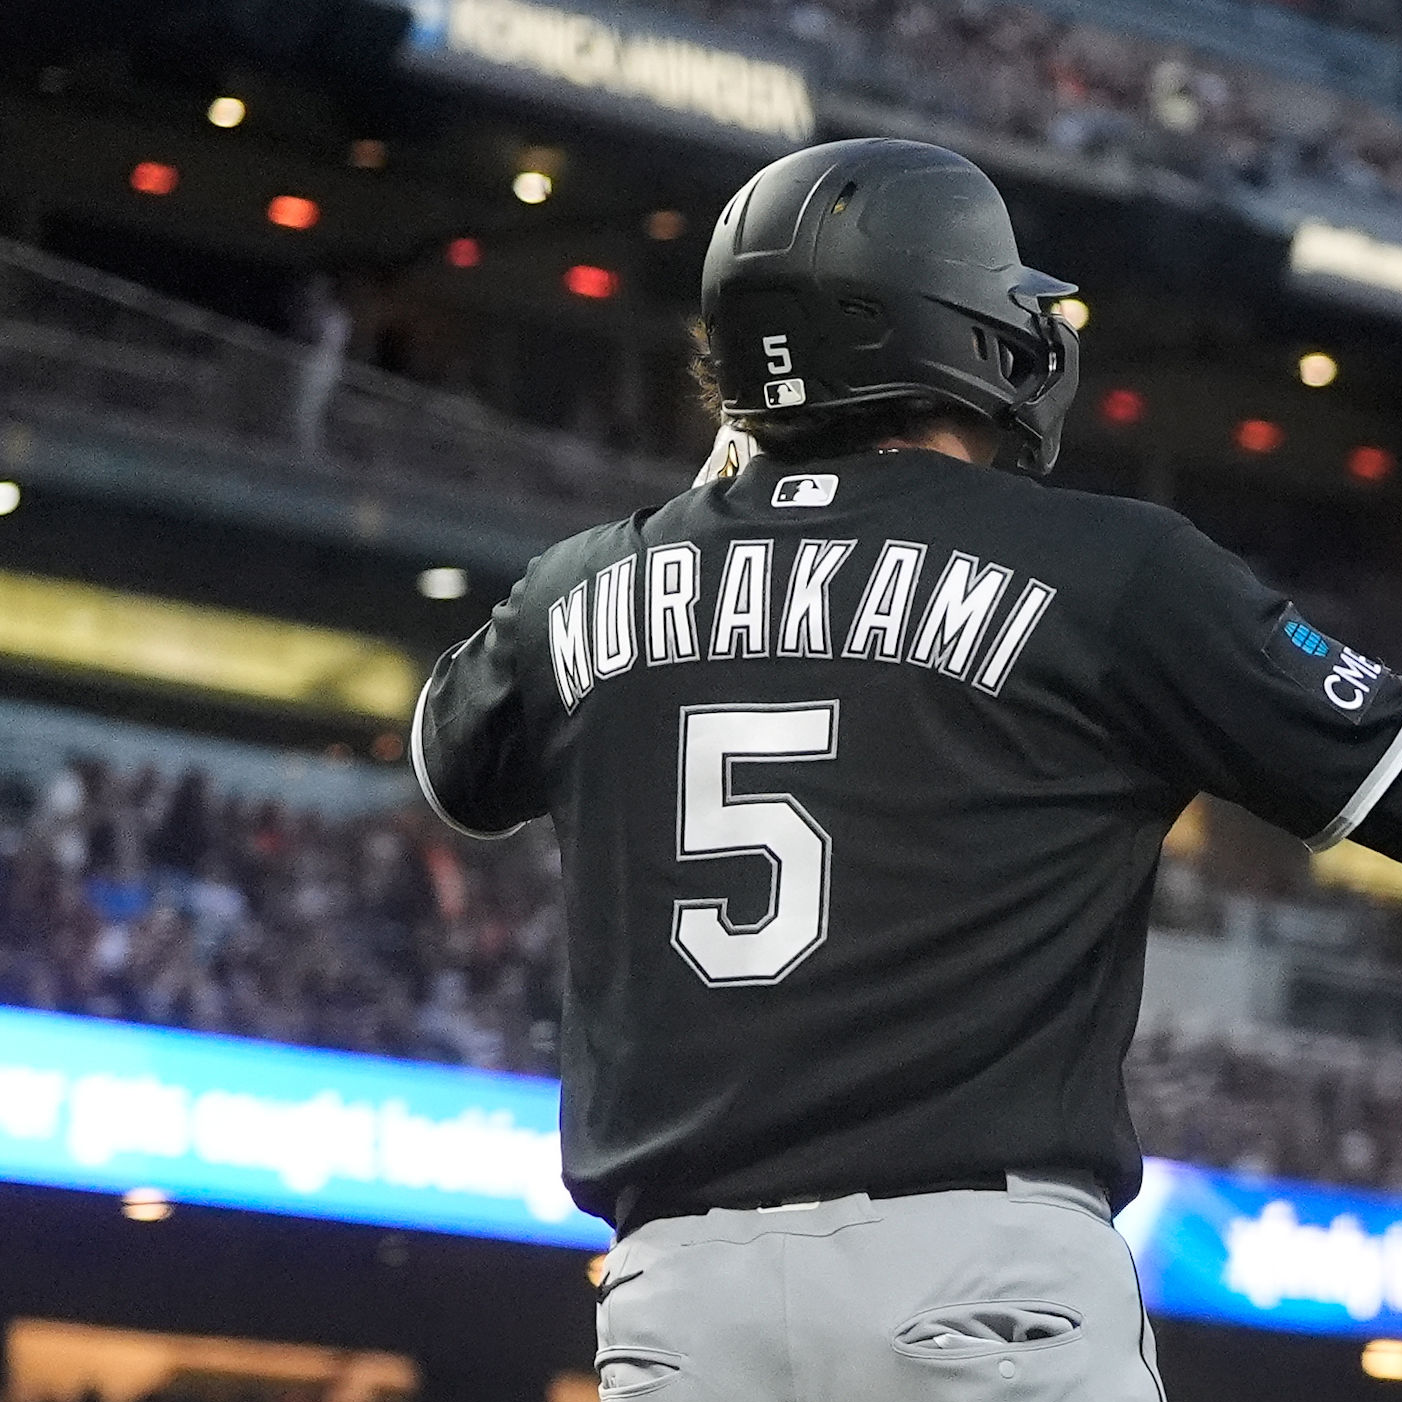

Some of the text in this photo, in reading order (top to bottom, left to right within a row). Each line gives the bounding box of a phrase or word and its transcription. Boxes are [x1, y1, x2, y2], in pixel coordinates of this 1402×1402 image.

[763, 335, 792, 375] 5
[548, 538, 1057, 716] MURAKAMI
[670, 699, 840, 988] 5
